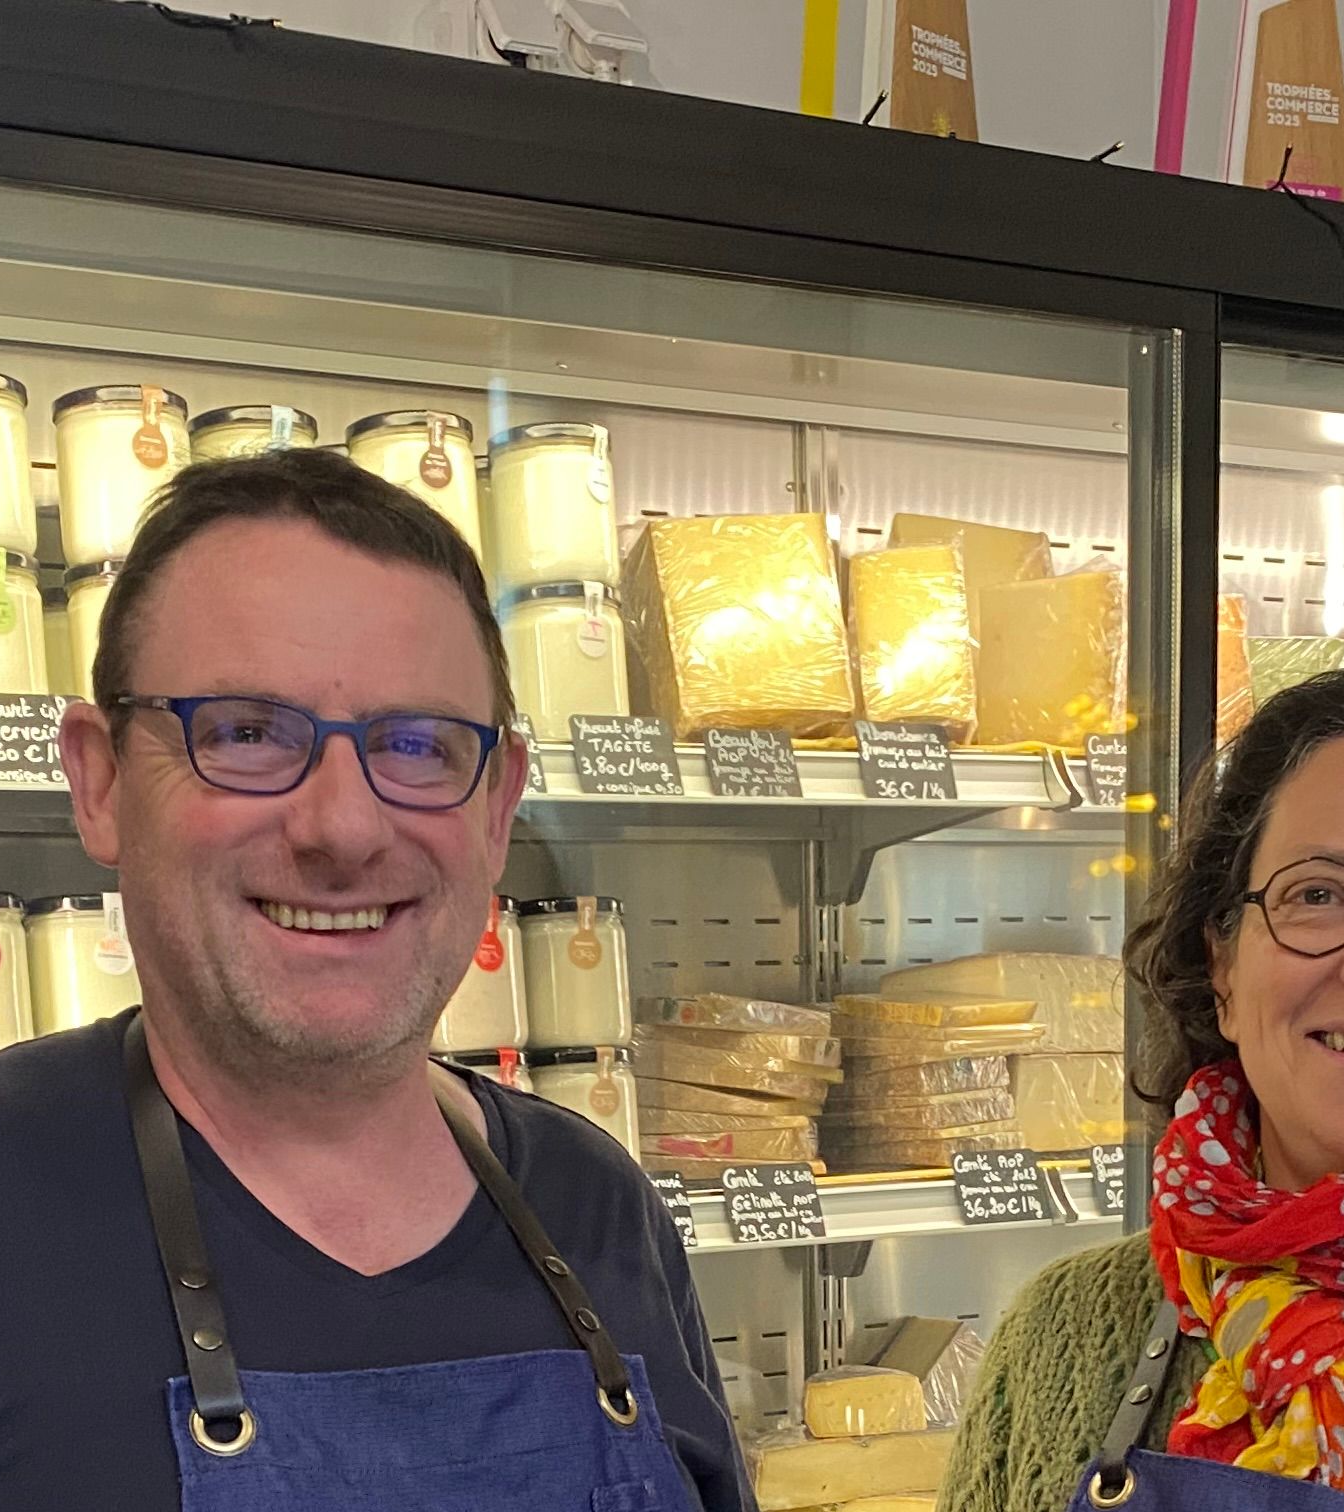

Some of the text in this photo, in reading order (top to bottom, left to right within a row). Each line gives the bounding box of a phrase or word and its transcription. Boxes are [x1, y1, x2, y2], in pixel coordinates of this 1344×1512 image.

[1266, 82, 1332, 101] TROPHÉES
[1266, 96, 1340, 117] COMMERCE
[1266, 112, 1301, 127] 2025
[39, 696, 67, 727] inf
[954, 1152, 1025, 1173] Comté AOP
[723, 1167, 764, 1189] Comté
